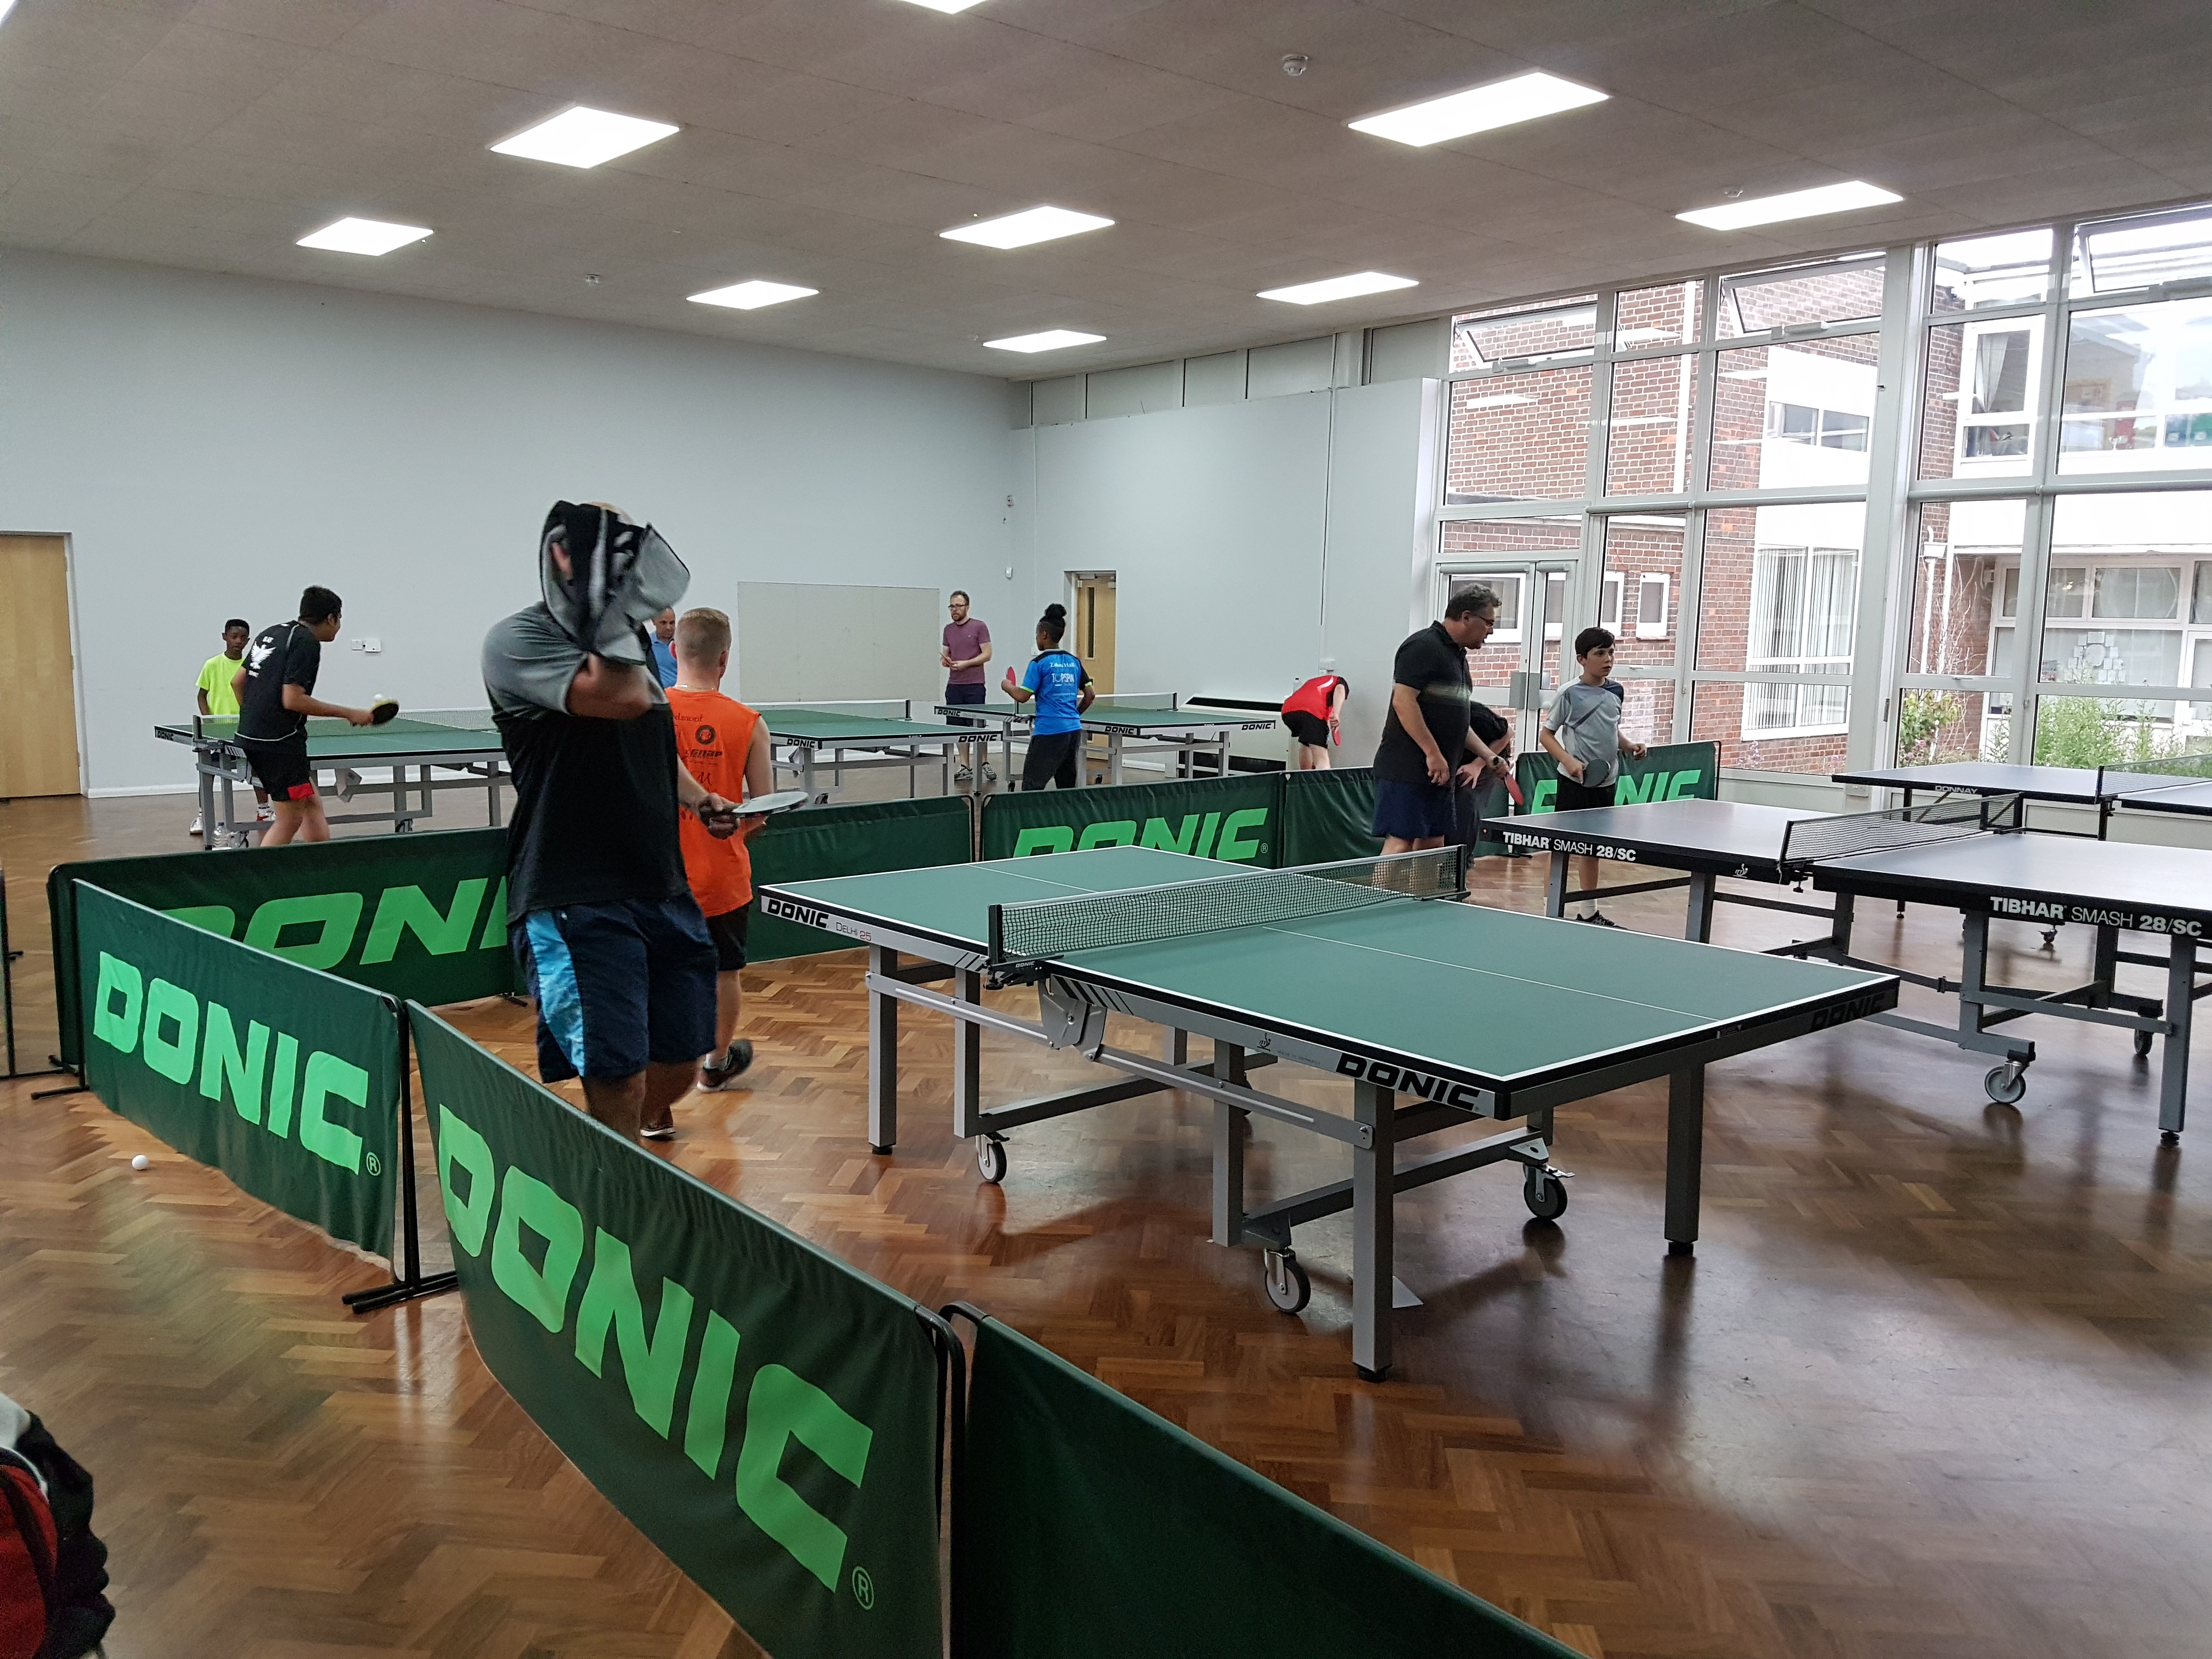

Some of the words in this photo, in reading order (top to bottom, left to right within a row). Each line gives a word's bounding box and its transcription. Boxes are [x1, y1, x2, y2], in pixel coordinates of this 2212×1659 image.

[787, 738, 815, 748] DONIC
[958, 734, 997, 743] DONIC
[1105, 726, 1135, 735] DONIC
[1935, 785, 1978, 794] DONNAY
[1503, 831, 1550, 849] TIBHAR
[1554, 839, 1593, 855] SMASH
[1596, 845, 1637, 861] 28/SC
[768, 899, 829, 929] DONIC
[860, 930, 872, 941] 25
[1990, 896, 2064, 919] TIBHAR
[2071, 906, 2133, 928] SMASH
[2139, 915, 2202, 936] 28/SC
[93, 951, 369, 1175] DONIC
[1335, 1053, 1481, 1111] DONIC
[439, 1103, 873, 1593] DONIC
